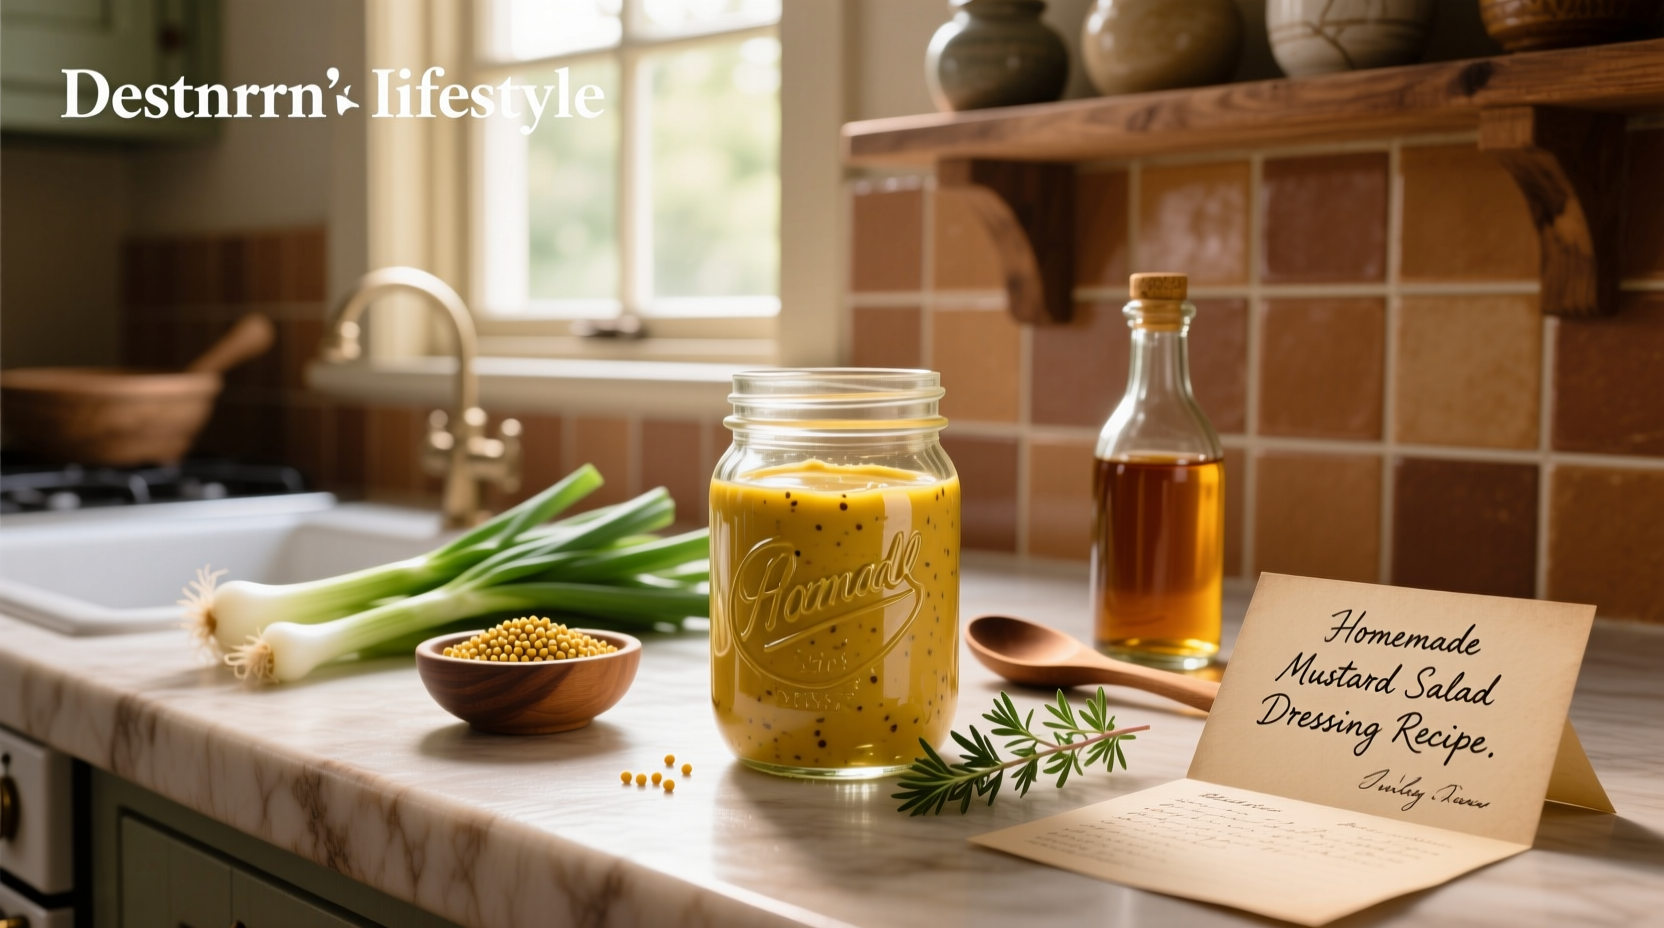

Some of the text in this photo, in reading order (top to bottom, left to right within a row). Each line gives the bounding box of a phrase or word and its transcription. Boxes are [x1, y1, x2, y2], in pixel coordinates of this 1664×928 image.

[1324, 609, 1481, 655] Homemade
[1275, 652, 1502, 706] Mustard Salad
[1256, 692, 1494, 766] Dressing Recipe.
